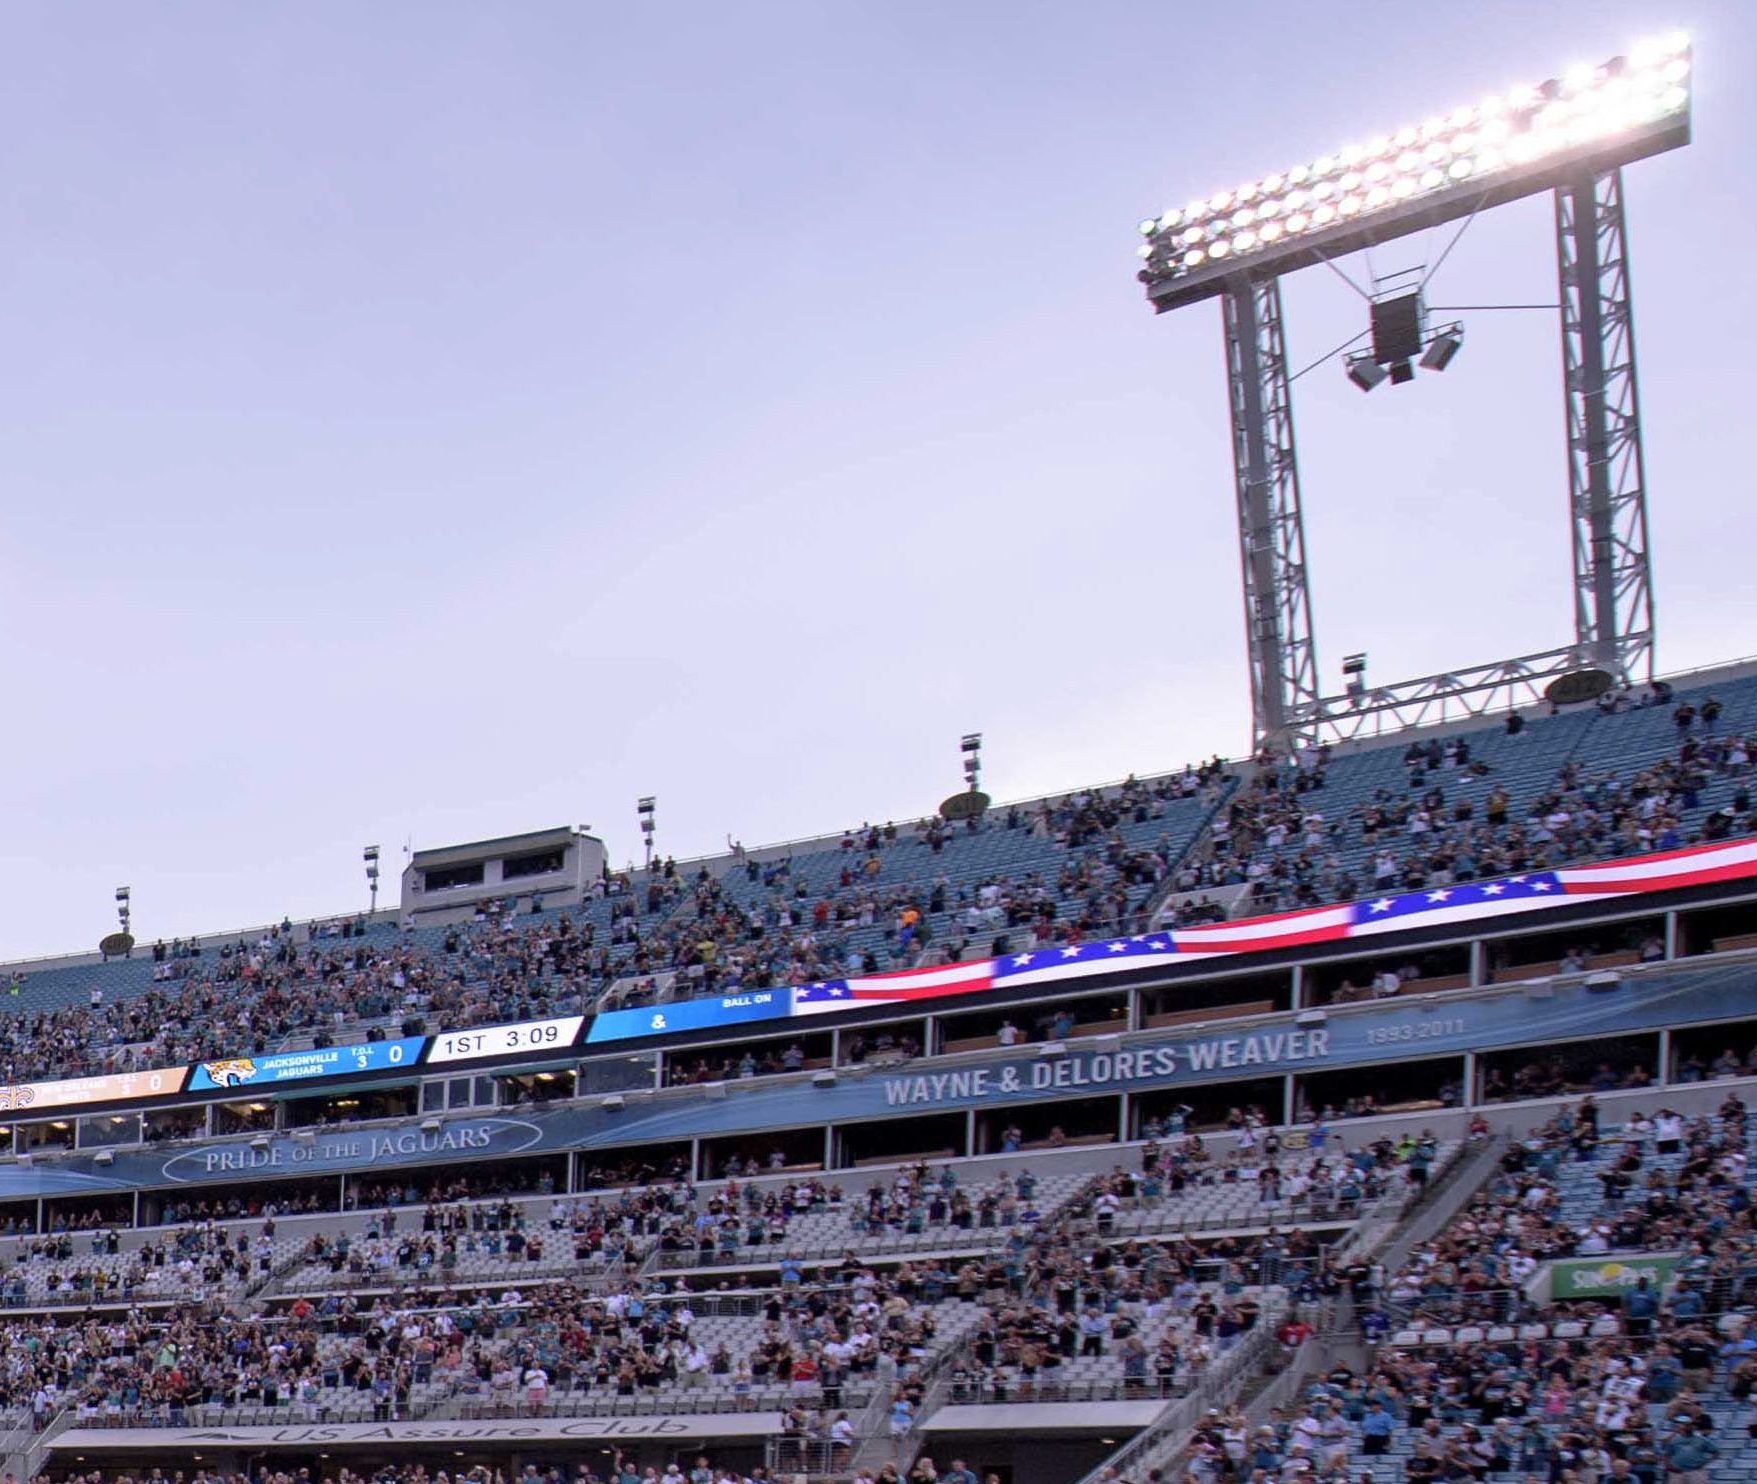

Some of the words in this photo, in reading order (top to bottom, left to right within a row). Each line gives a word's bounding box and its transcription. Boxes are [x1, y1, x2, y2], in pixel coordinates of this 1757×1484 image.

[722, 997, 752, 1008] BALL
[445, 1034, 487, 1054] 1ST
[506, 1026, 558, 1048] 3:09
[263, 1052, 339, 1070] JACKSONVILLE
[358, 1056, 367, 1069] 3
[390, 1046, 402, 1063] 0
[275, 1064, 324, 1079] JAGUARS
[884, 1069, 990, 1106] WAYNE
[999, 1066, 1020, 1094] &
[1031, 1046, 1176, 1091] DELORES
[1188, 1028, 1330, 1072] WEAVER
[150, 1074, 161, 1091] 0
[206, 1147, 283, 1173] PRIDE
[292, 1147, 315, 1163] OF
[323, 1142, 361, 1159] THE
[369, 1125, 491, 1162] JAGUARS
[271, 1428, 347, 1442] US
[352, 1424, 543, 1441] Assure
[559, 1419, 689, 1437] Club
